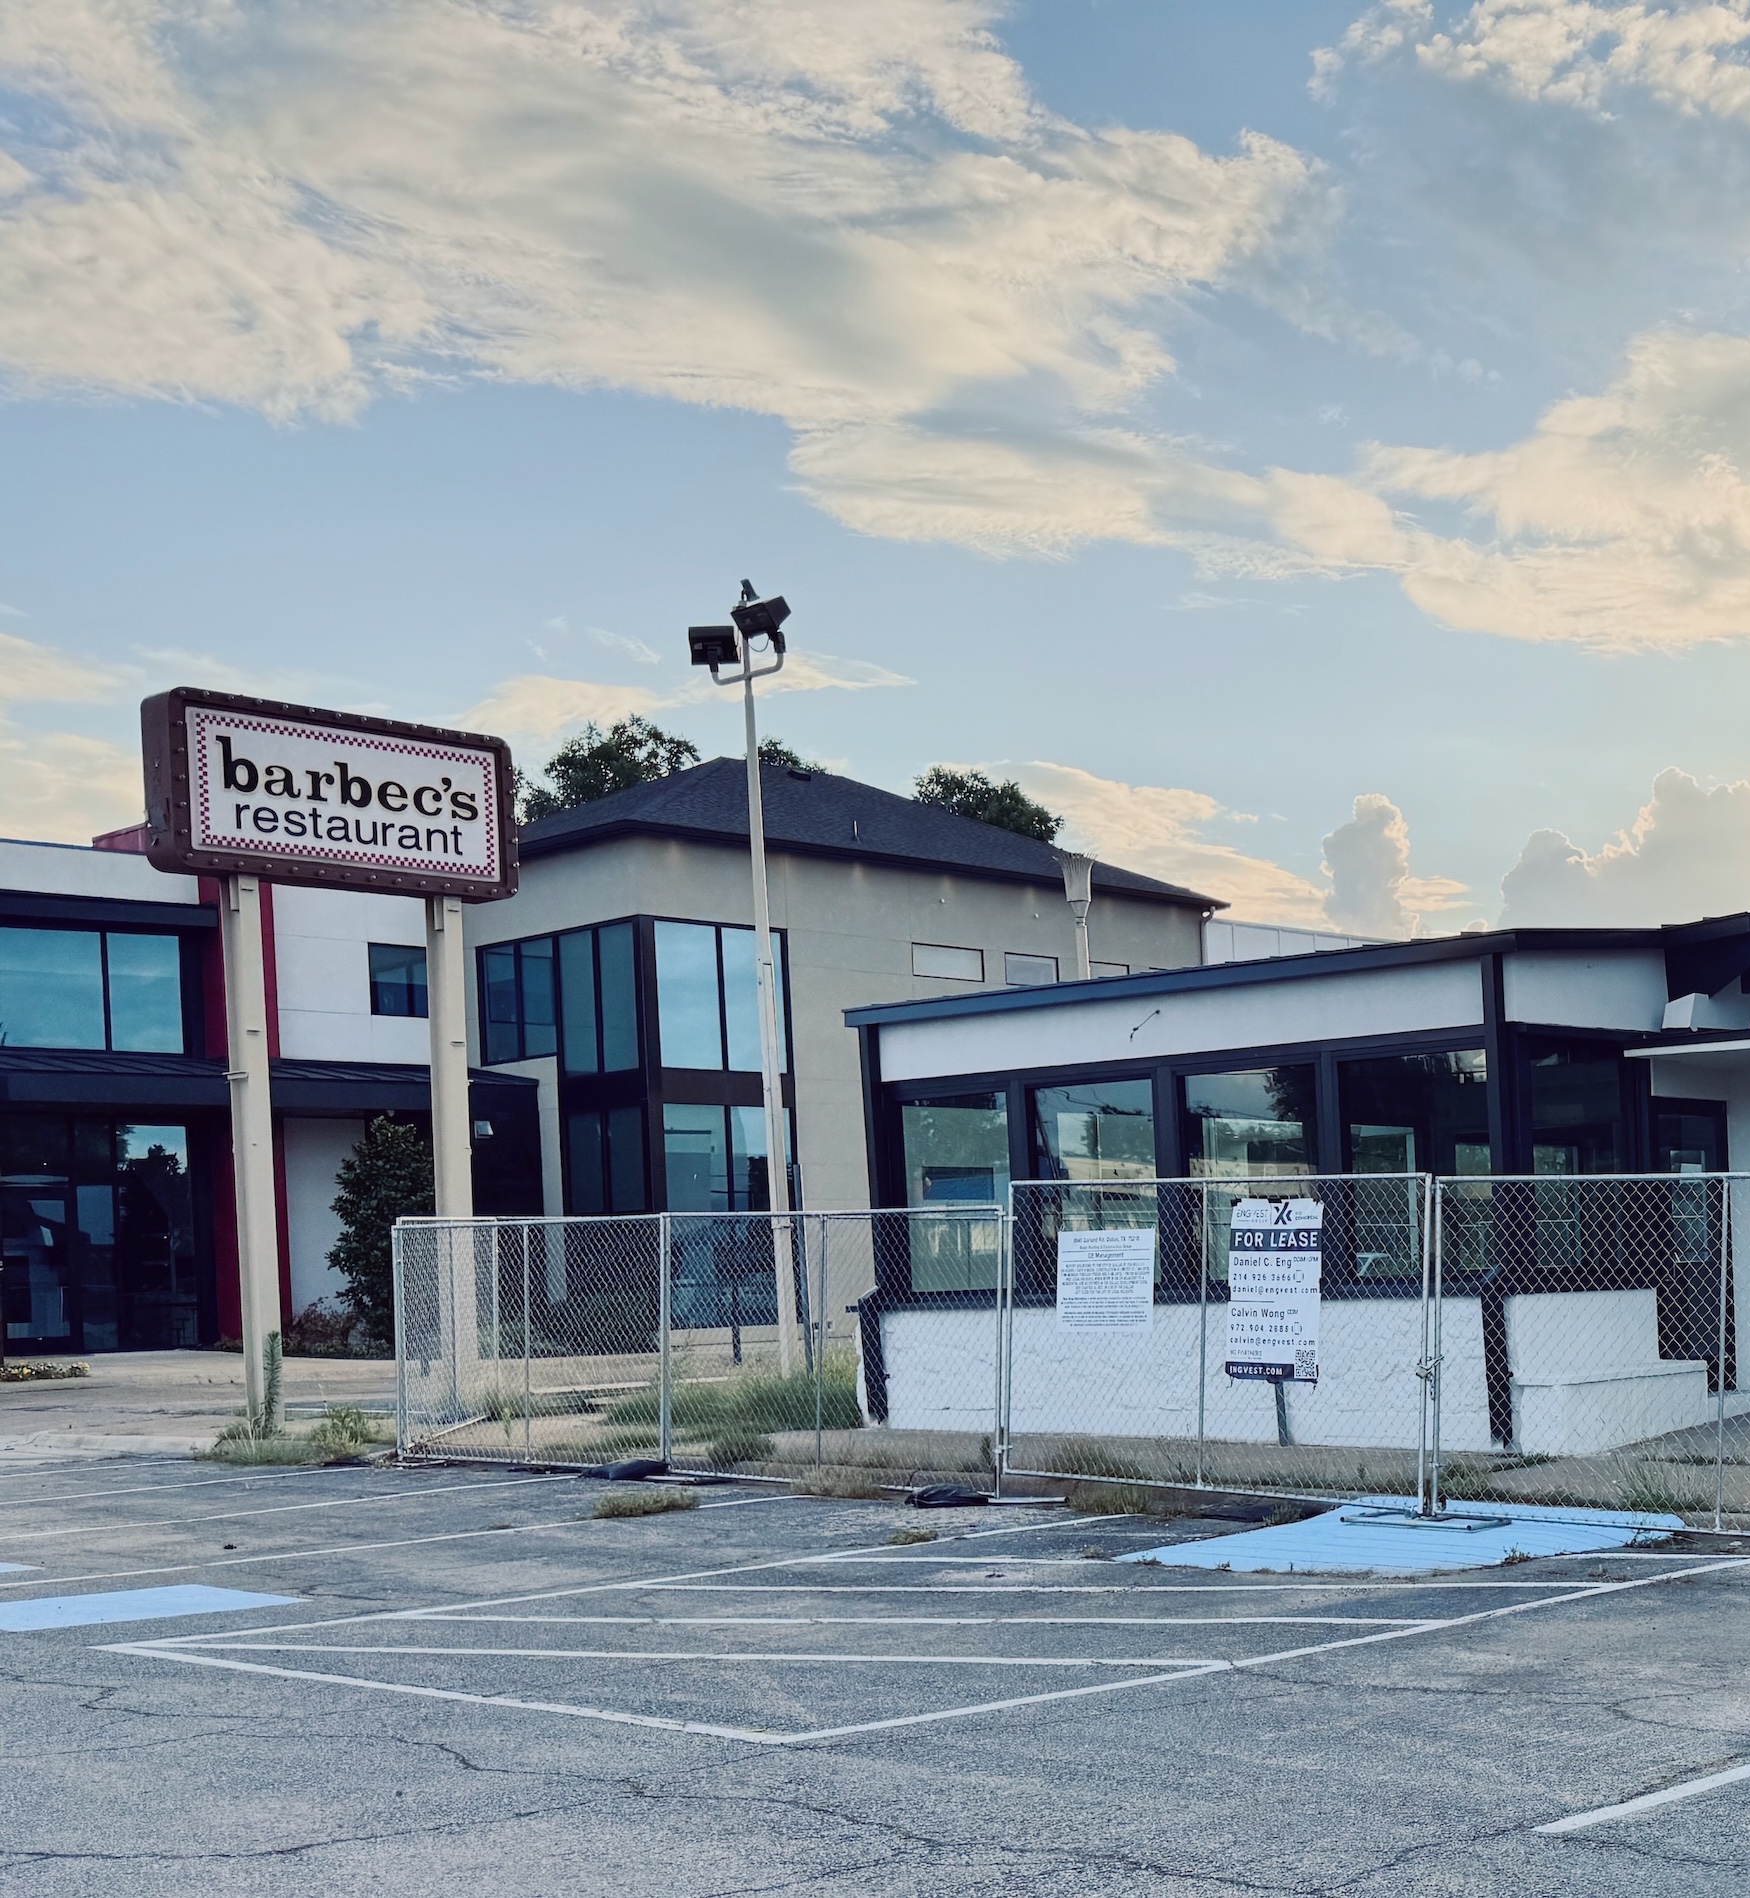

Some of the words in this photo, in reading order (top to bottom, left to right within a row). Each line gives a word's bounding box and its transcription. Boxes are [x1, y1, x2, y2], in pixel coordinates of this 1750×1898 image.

[215, 735, 479, 821] barbec's
[235, 803, 463, 856] restaurant
[1234, 1232, 1264, 1247] FOR
[1270, 1232, 1318, 1248] LEASE
[1233, 1257, 1261, 1266] Daniel
[1264, 1257, 1272, 1266] C.
[1276, 1257, 1292, 1268] Eng
[1232, 1285, 1318, 1295] daniel@engvest.com
[1231, 1307, 1258, 1317] Calvin
[1261, 1308, 1285, 1320] Wong
[1230, 1336, 1315, 1346] calvin@engvest.com
